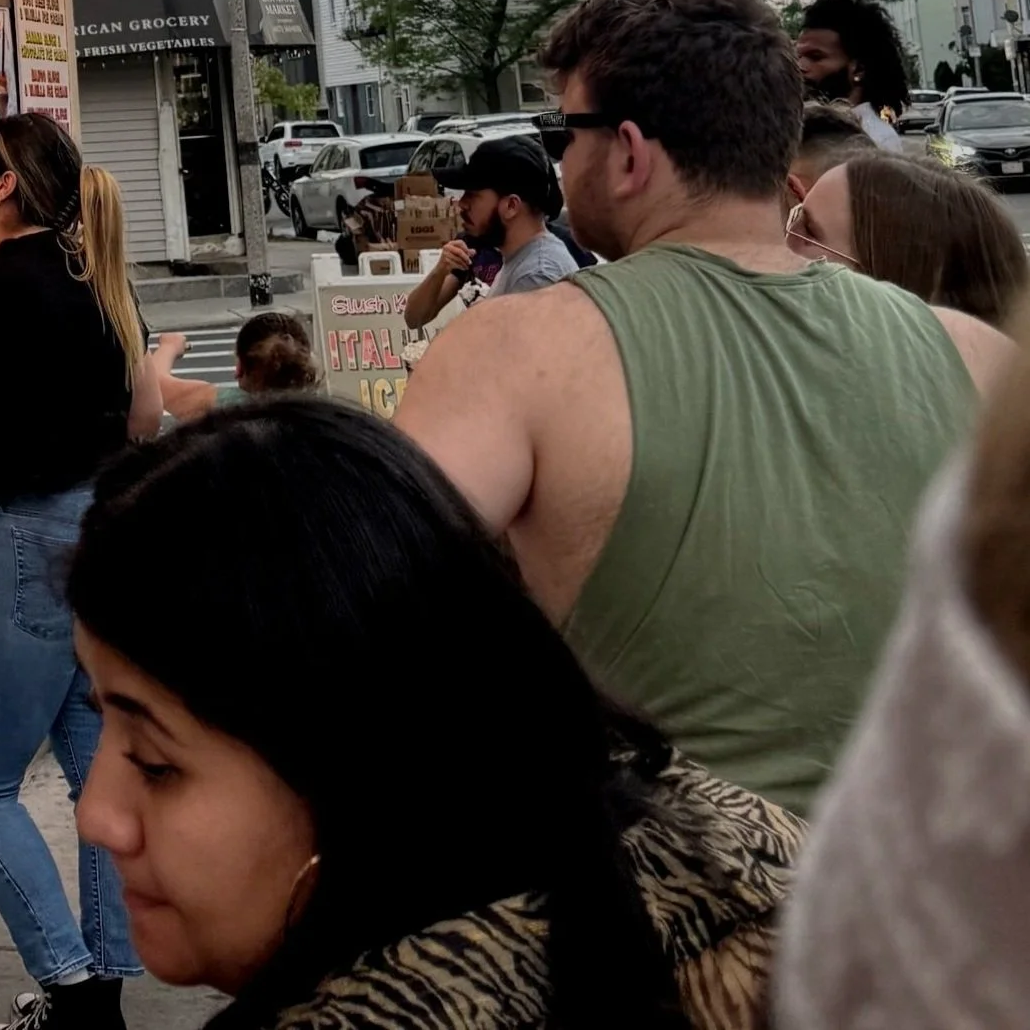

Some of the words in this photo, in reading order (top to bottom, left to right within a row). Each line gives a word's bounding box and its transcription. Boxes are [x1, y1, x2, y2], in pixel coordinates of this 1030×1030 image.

[265, 5, 297, 16] MARKET
[129, 15, 210, 30] GROCERY
[84, 45, 126, 57] FRESH
[130, 38, 215, 53] VEGETABLES
[411, 226, 434, 234] EGGS
[331, 294, 390, 315] Slush
